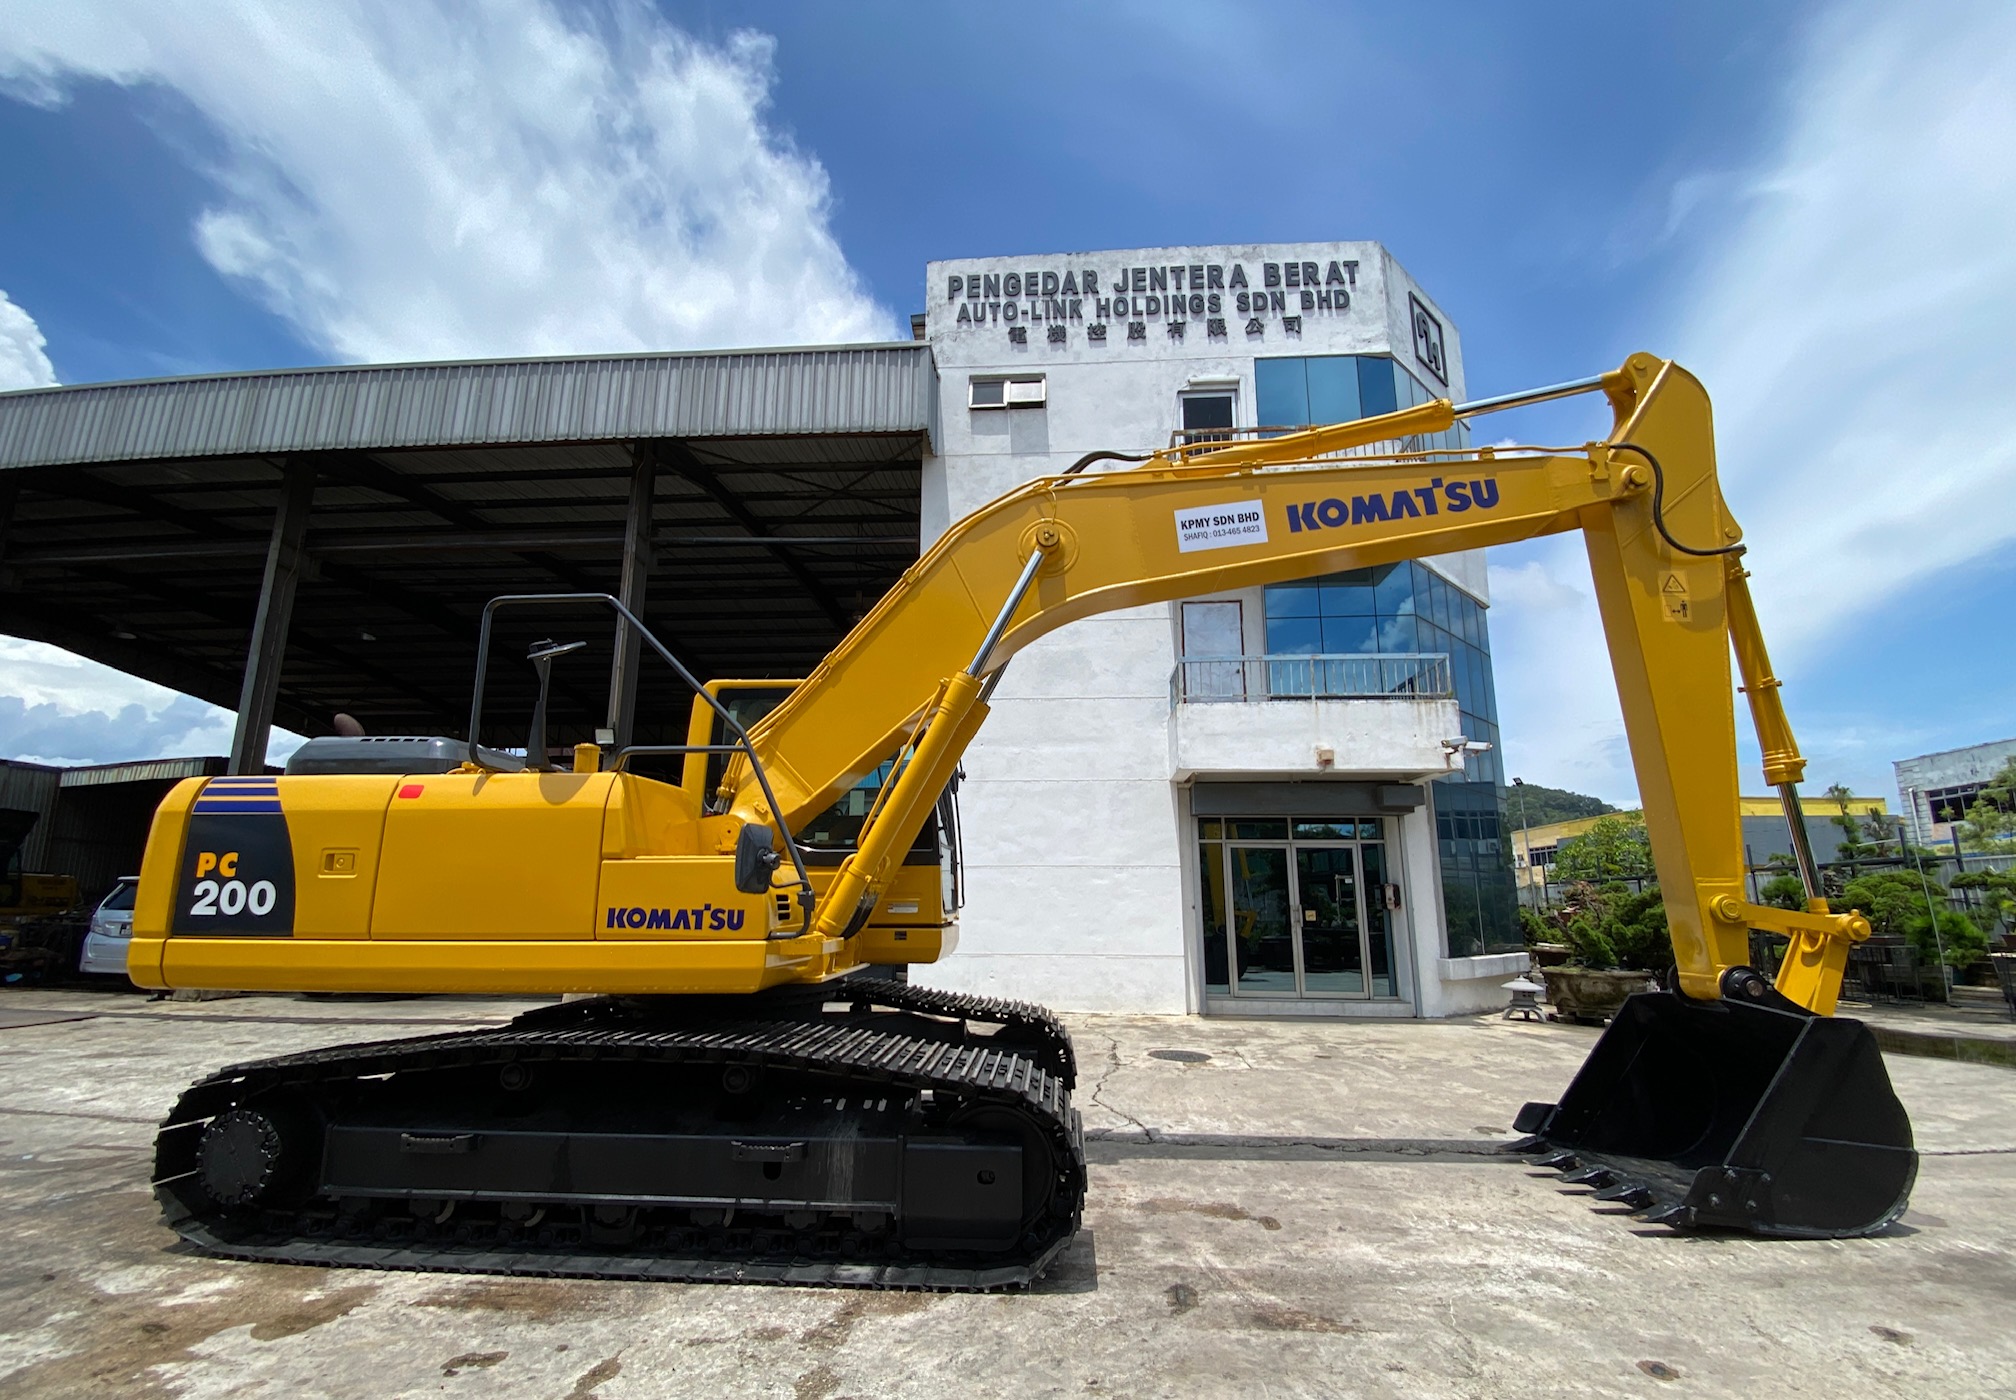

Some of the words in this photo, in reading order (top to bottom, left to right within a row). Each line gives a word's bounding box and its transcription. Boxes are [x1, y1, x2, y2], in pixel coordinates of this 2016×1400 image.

[948, 270, 1099, 300] PENGEDAR
[1113, 264, 1248, 293] JENTERA
[1263, 260, 1359, 287] BERAT
[956, 298, 1083, 322] AUTO-LINK
[1096, 292, 1222, 318] HOLDINGS
[1236, 291, 1286, 312] SDN
[1300, 289, 1351, 310] BHD
[1286, 477, 1500, 533] KOMATSU
[1180, 517, 1211, 531] KPMY
[1213, 514, 1235, 527] SDN
[1237, 511, 1260, 524] BHD
[1183, 530, 1209, 542] SHAFIQ
[1242, 524, 1261, 534] 4823
[195, 851, 240, 878] PC
[189, 879, 277, 916] 200
[606, 903, 745, 931] KOMATSU
